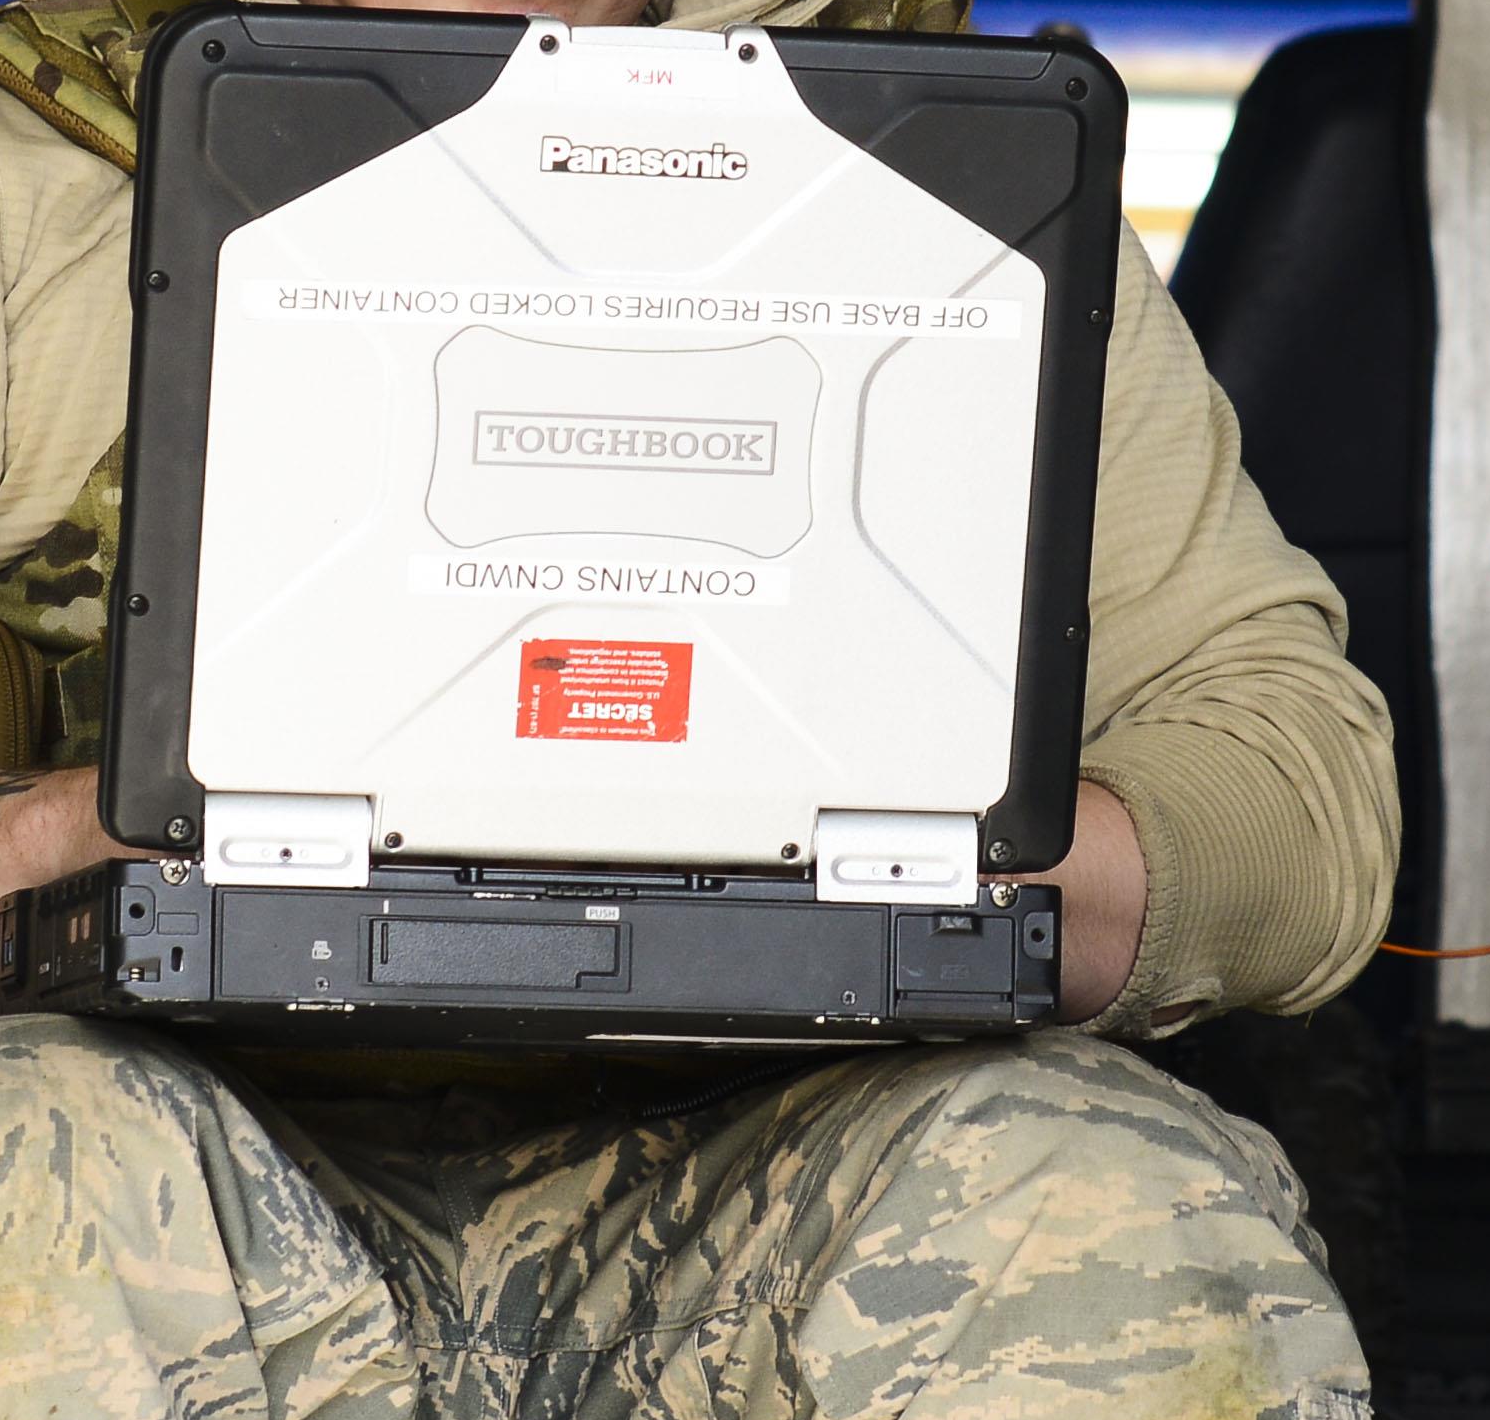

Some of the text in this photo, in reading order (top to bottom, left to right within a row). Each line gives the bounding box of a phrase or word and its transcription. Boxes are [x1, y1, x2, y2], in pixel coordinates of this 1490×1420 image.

[625, 68, 673, 86] MFK
[540, 136, 748, 181] Panasonic
[278, 286, 990, 330] OFF BASE USE REQUIRES LOCKED CONTAINER
[486, 422, 766, 464] TOUGHBOOK
[444, 561, 757, 596] CONTAINS CNWDI
[563, 688, 597, 698] Property
[597, 690, 644, 700] Government
[567, 702, 653, 721] SECRET
[588, 907, 617, 919] PUSH
